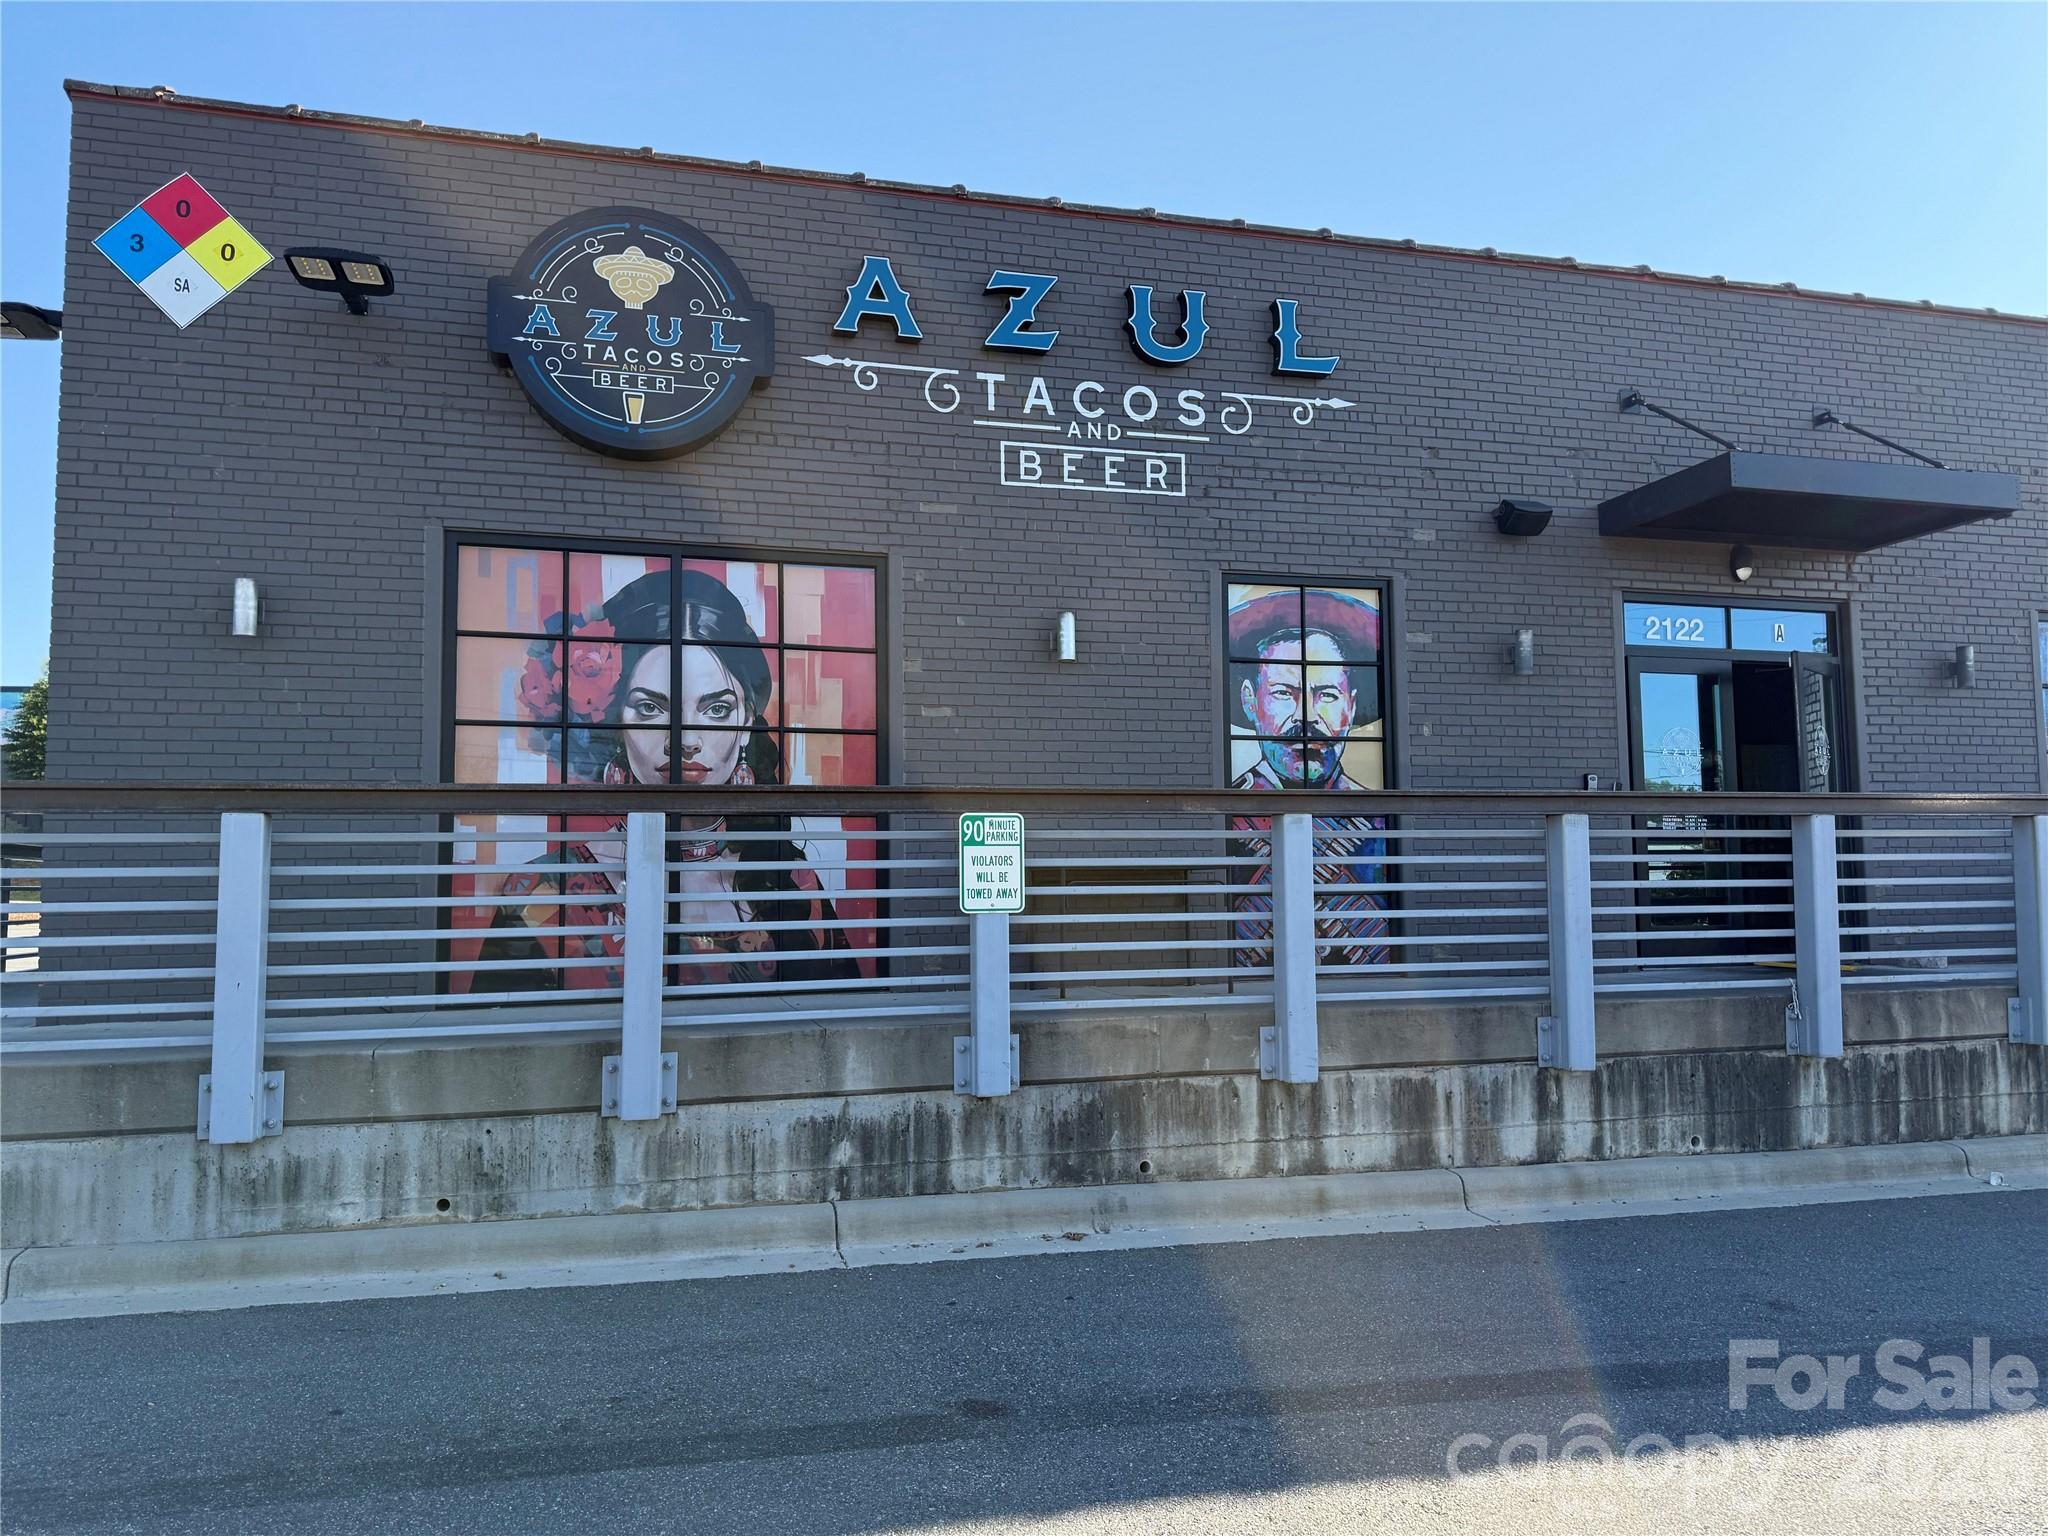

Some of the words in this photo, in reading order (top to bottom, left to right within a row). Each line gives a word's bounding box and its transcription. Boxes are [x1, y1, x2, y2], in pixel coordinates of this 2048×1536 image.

[176, 199, 191, 218] 0
[129, 234, 144, 252] 3
[220, 243, 236, 262] 0
[174, 277, 191, 293] SA
[833, 255, 1341, 379] AZUL
[522, 303, 742, 354] AZUL
[583, 343, 684, 368] TACOS
[621, 363, 646, 373] AND
[601, 373, 667, 391] BEER
[976, 371, 1206, 426] TACOS
[1067, 421, 1122, 441] AND
[1019, 449, 1168, 489] BEER
[1646, 616, 1705, 642] 2122
[1775, 624, 1785, 642] A
[963, 820, 984, 842] 90
[988, 820, 1016, 831] MINUTE
[986, 831, 1019, 842] PARKING
[971, 855, 1014, 867] VIOLATORS
[976, 872, 995, 883] WILL
[998, 872, 1009, 883] BE
[966, 888, 993, 899] TOWED
[995, 888, 1019, 899] AWAY
